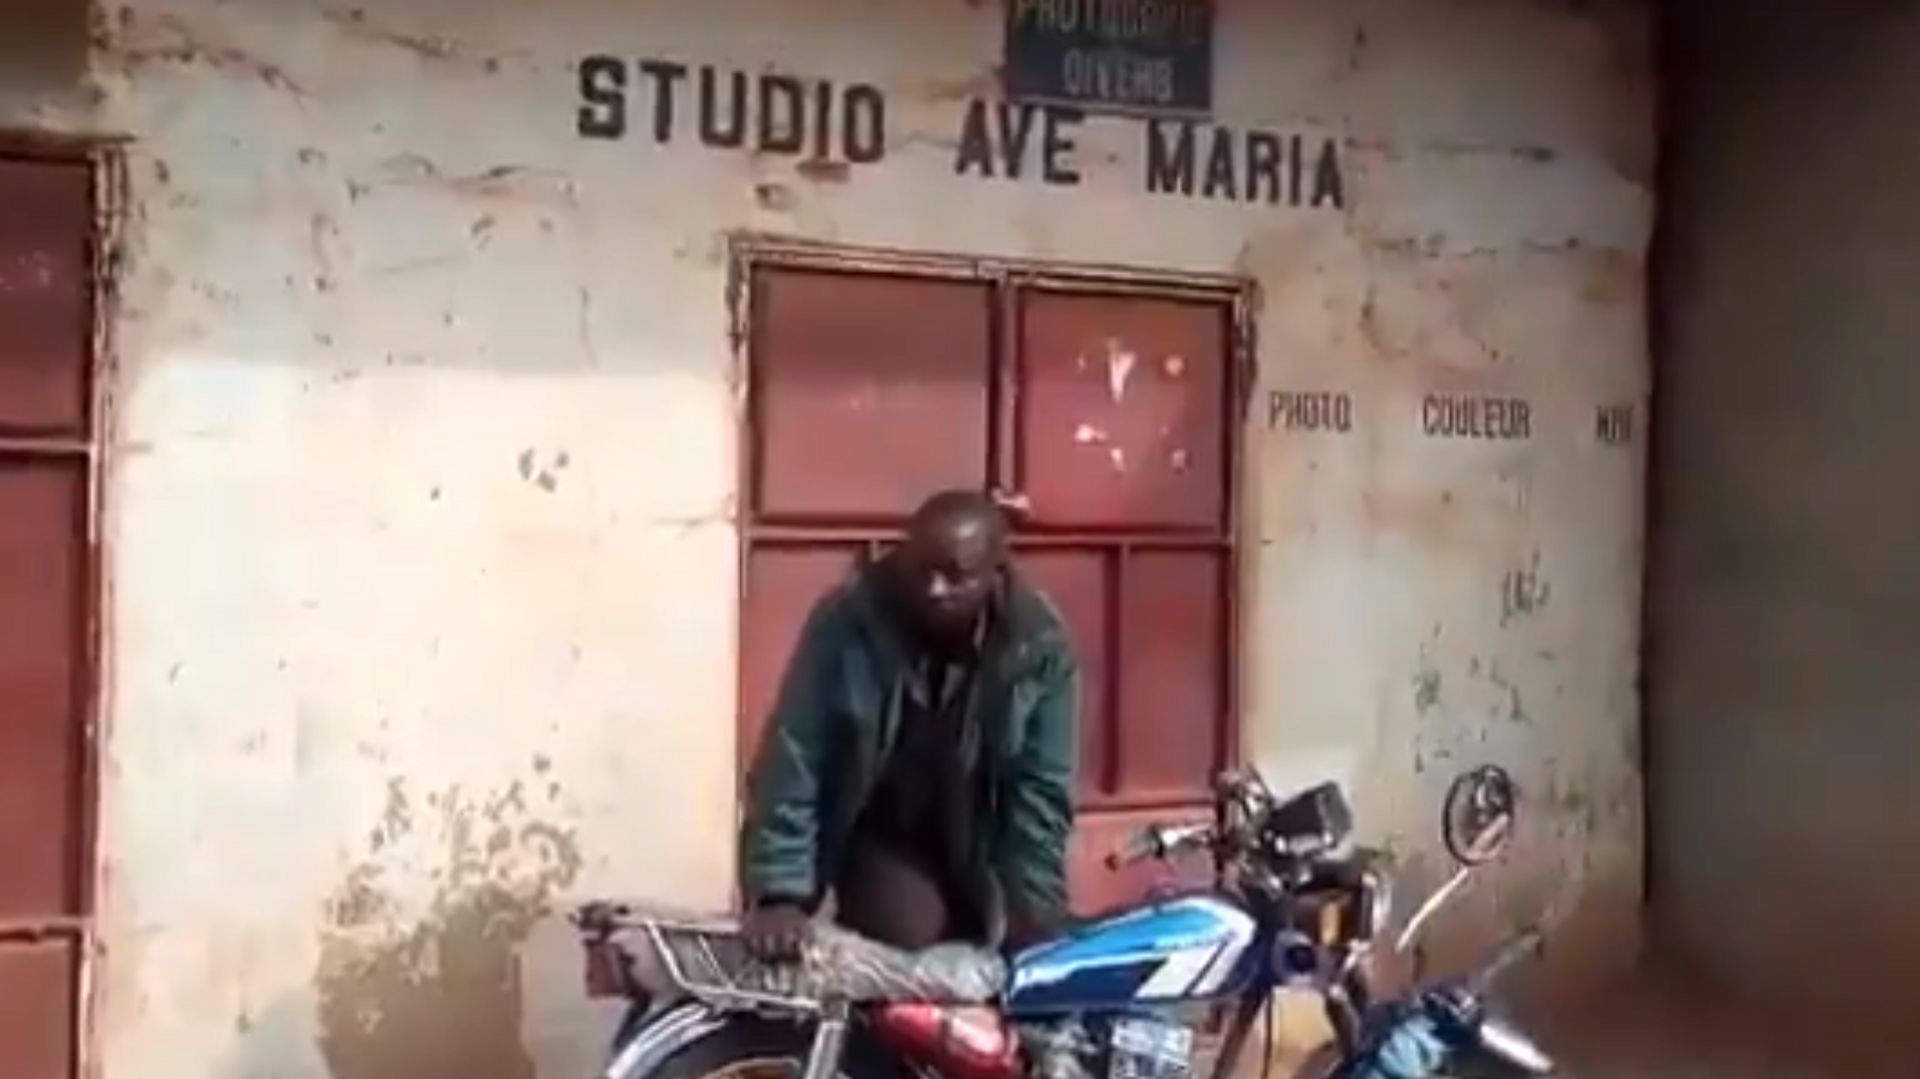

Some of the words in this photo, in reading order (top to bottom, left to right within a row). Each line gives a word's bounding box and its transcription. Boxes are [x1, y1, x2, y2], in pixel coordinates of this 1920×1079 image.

[577, 55, 885, 164] STUDIO
[955, 97, 1081, 184] AVE
[1146, 118, 1346, 210] MARIA
[1269, 390, 1352, 432] PHOTO
[1422, 393, 1531, 440] COULEUR
